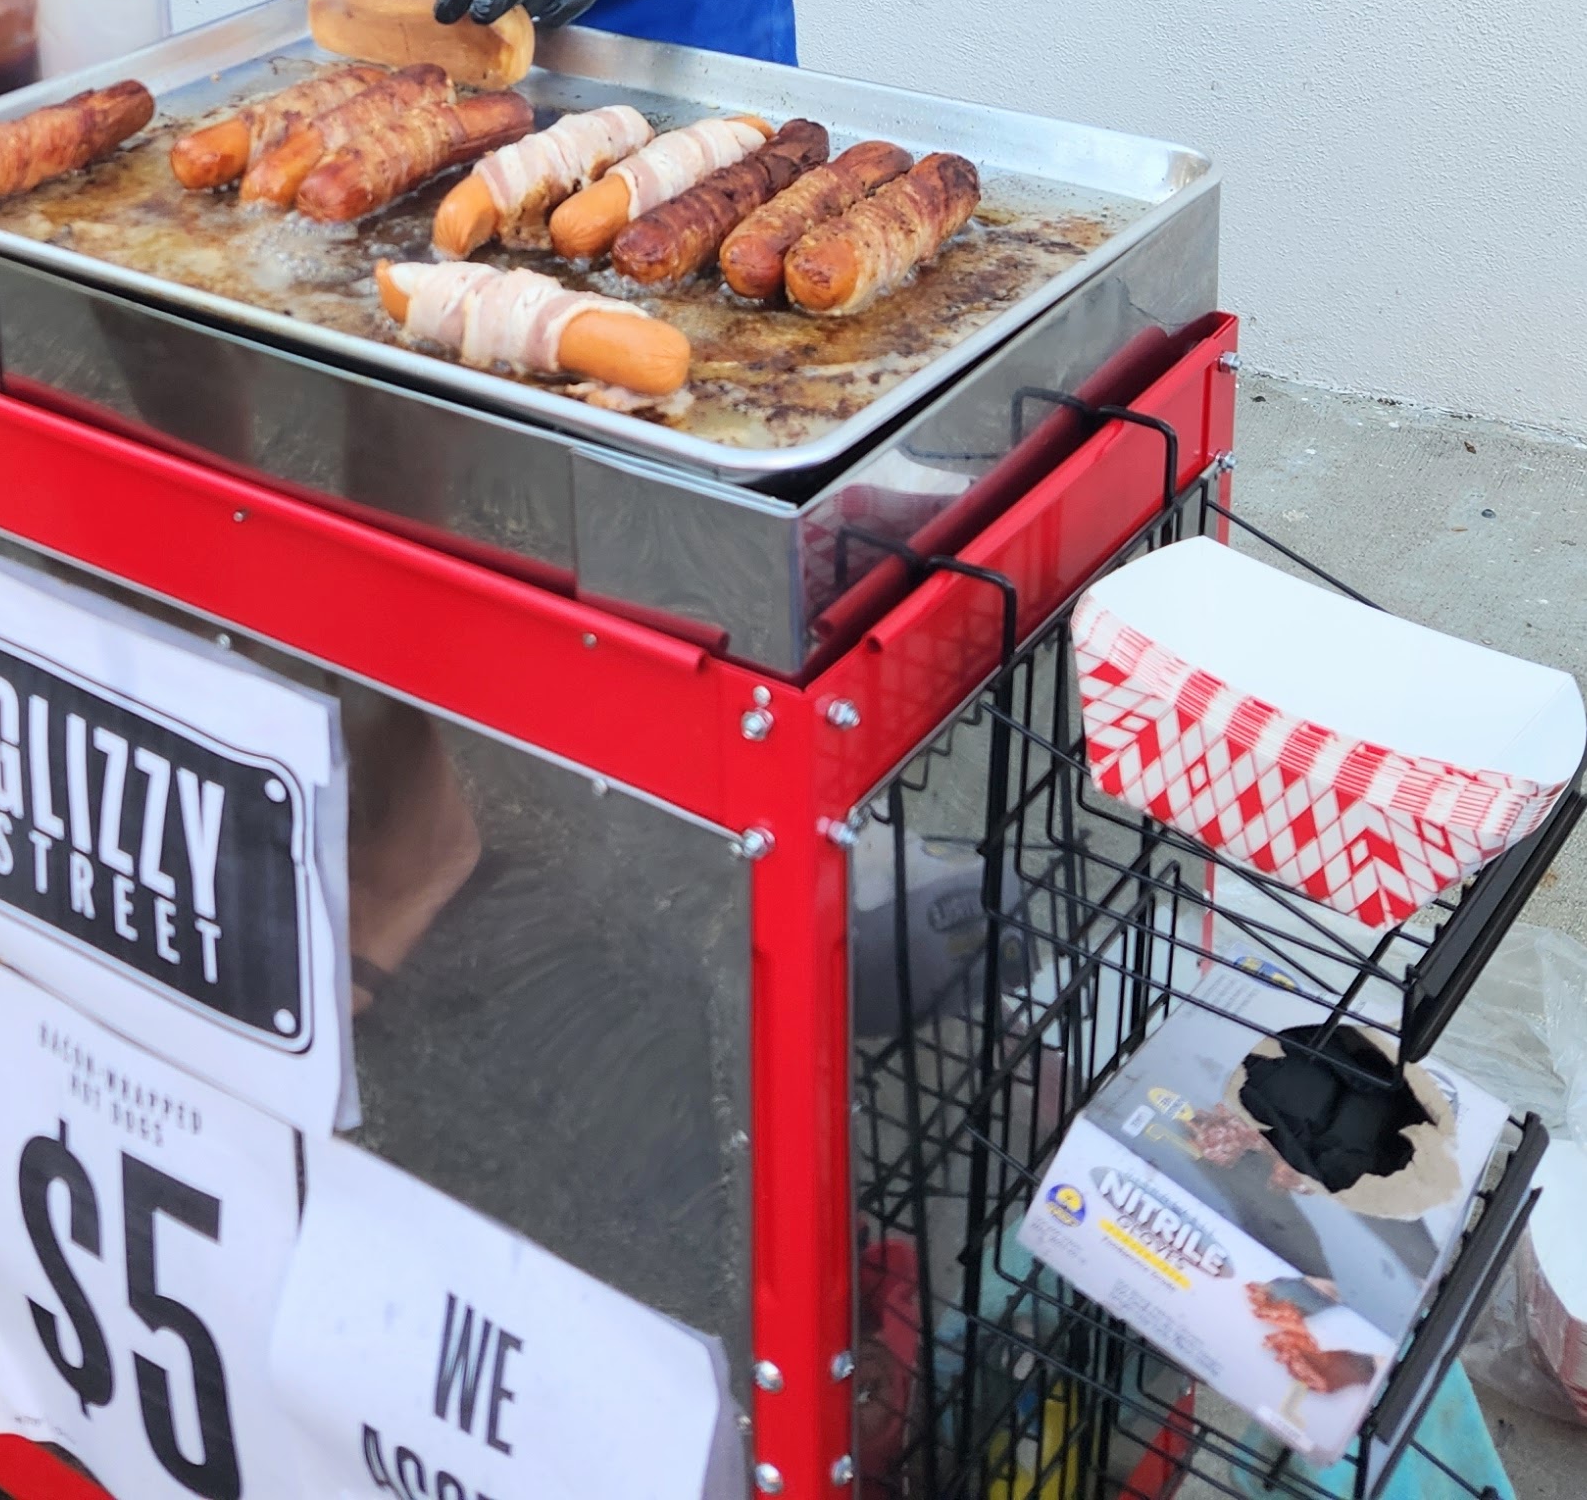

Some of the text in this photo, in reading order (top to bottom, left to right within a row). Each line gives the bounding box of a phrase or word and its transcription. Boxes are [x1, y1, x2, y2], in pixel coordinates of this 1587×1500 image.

[112, 1100, 164, 1148] DOGS
[1100, 1168, 1228, 1276] NITRILE
[18, 1118, 243, 1500] $5
[432, 1291, 525, 1457] WE
